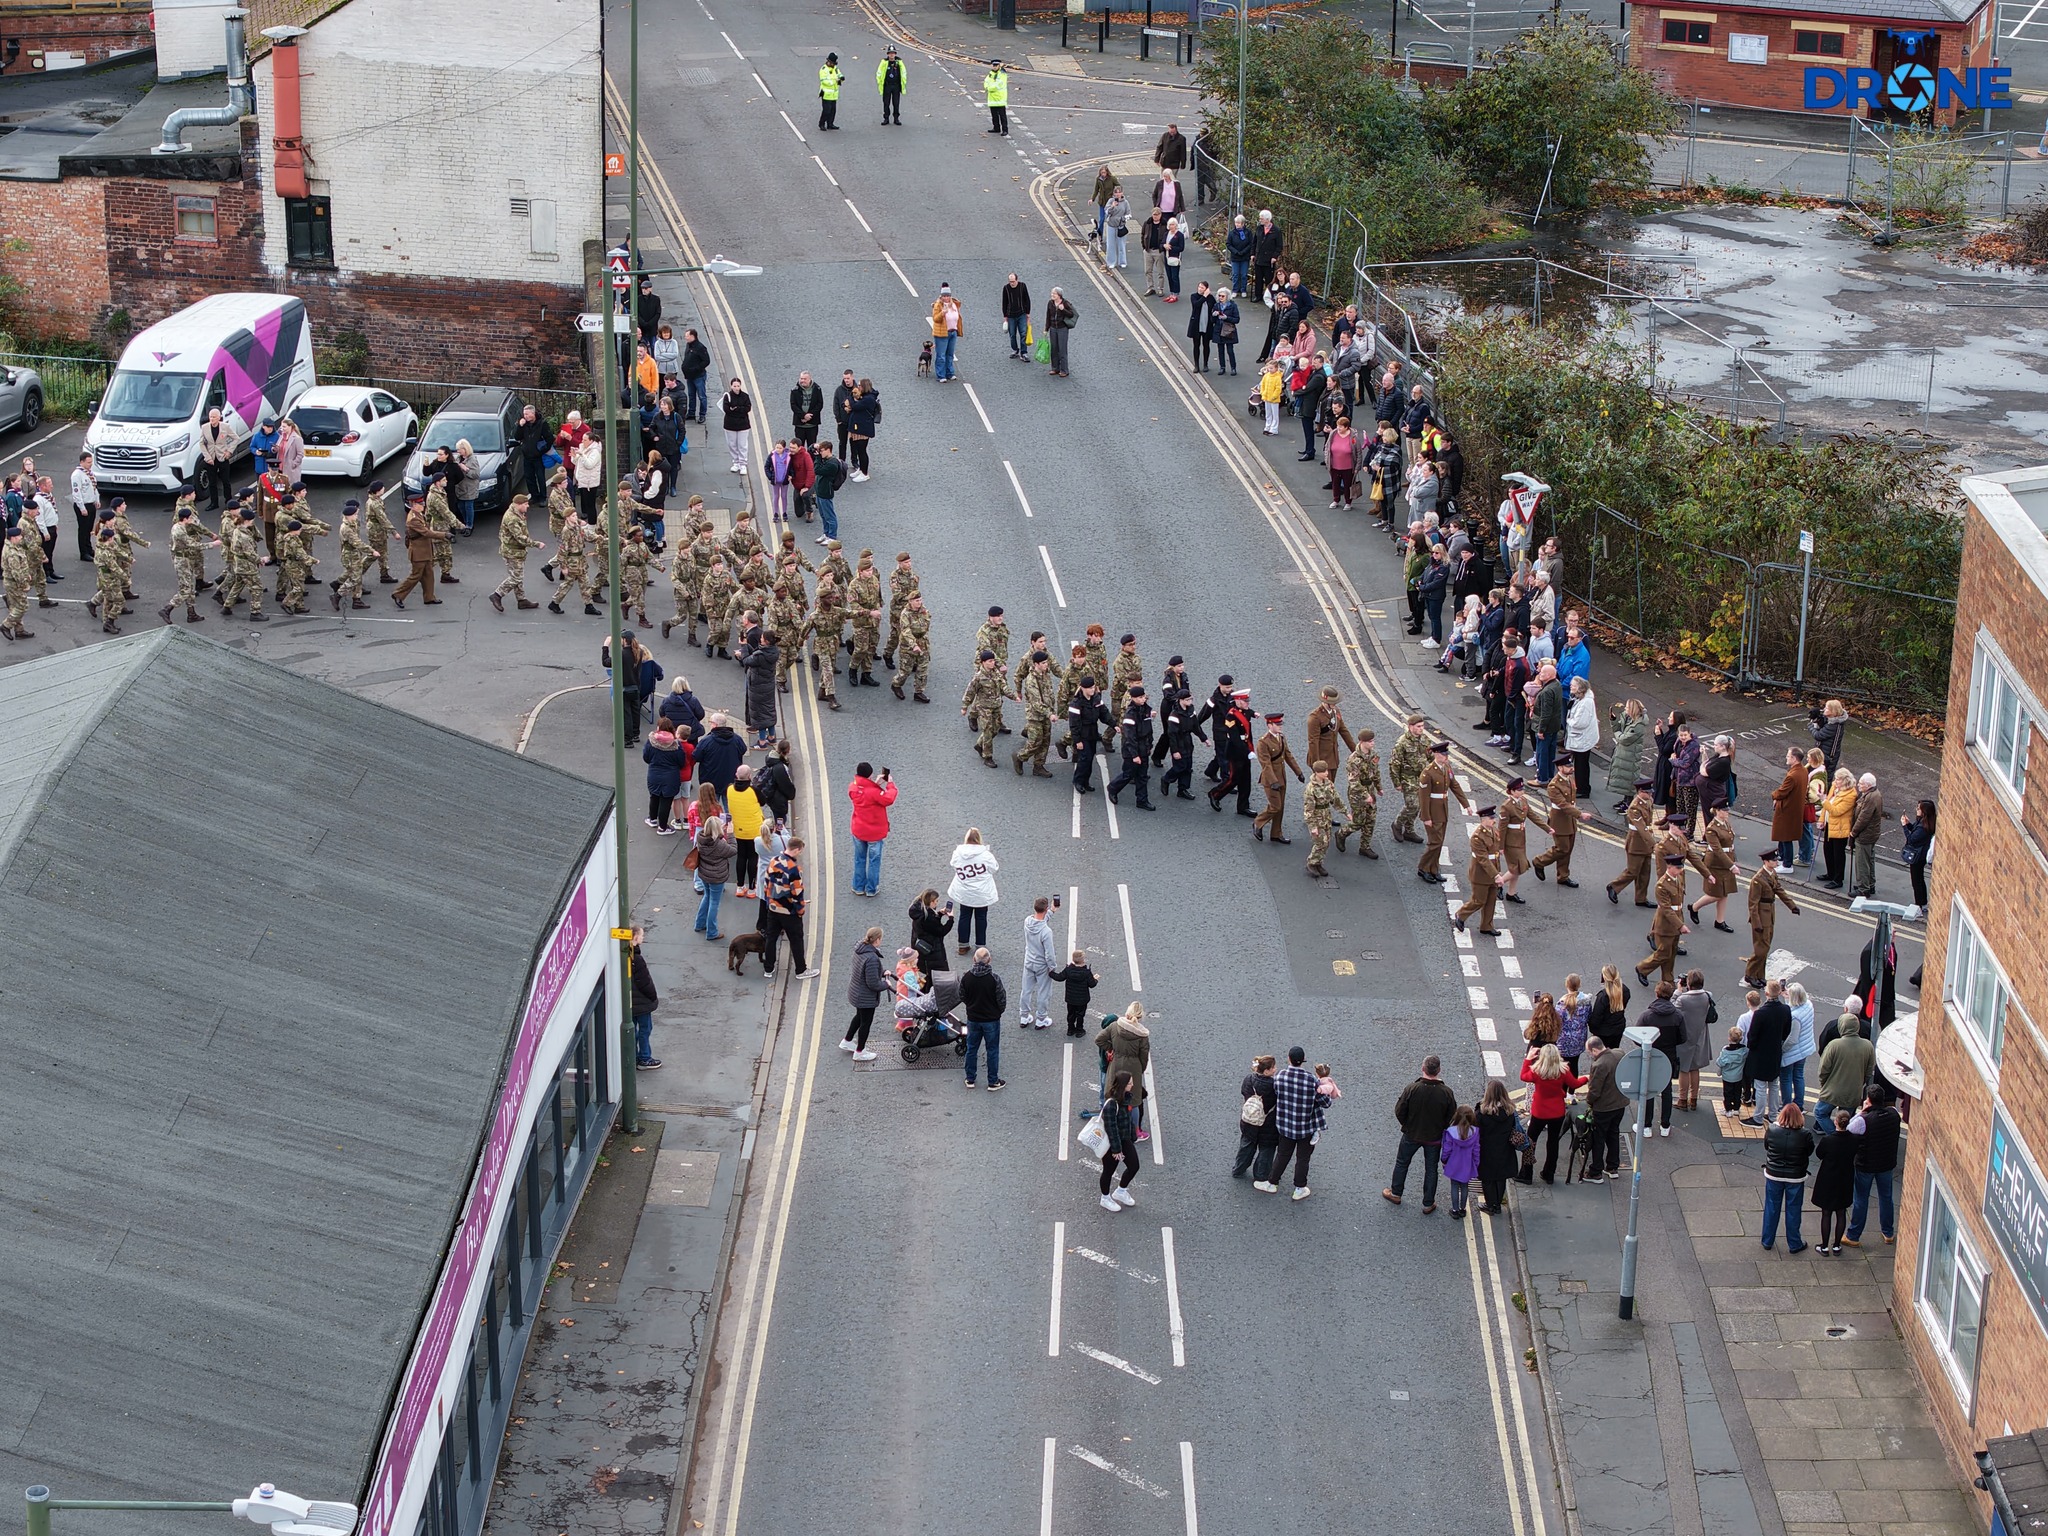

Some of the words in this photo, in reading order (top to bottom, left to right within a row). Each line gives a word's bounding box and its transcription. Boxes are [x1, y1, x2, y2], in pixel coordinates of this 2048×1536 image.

[100, 434, 153, 444] CENTRE
[101, 427, 166, 436] WINDOW
[1520, 492, 1537, 501] GIVE
[1738, 723, 1792, 740] ONLY
[956, 863, 987, 880] 639
[466, 1203, 483, 1273] Buy
[483, 1135, 503, 1214] Sofas
[503, 1059, 524, 1146] Direct
[2000, 1144, 2048, 1266] HEWE
[1990, 1171, 2036, 1265] RECRUITMENT
